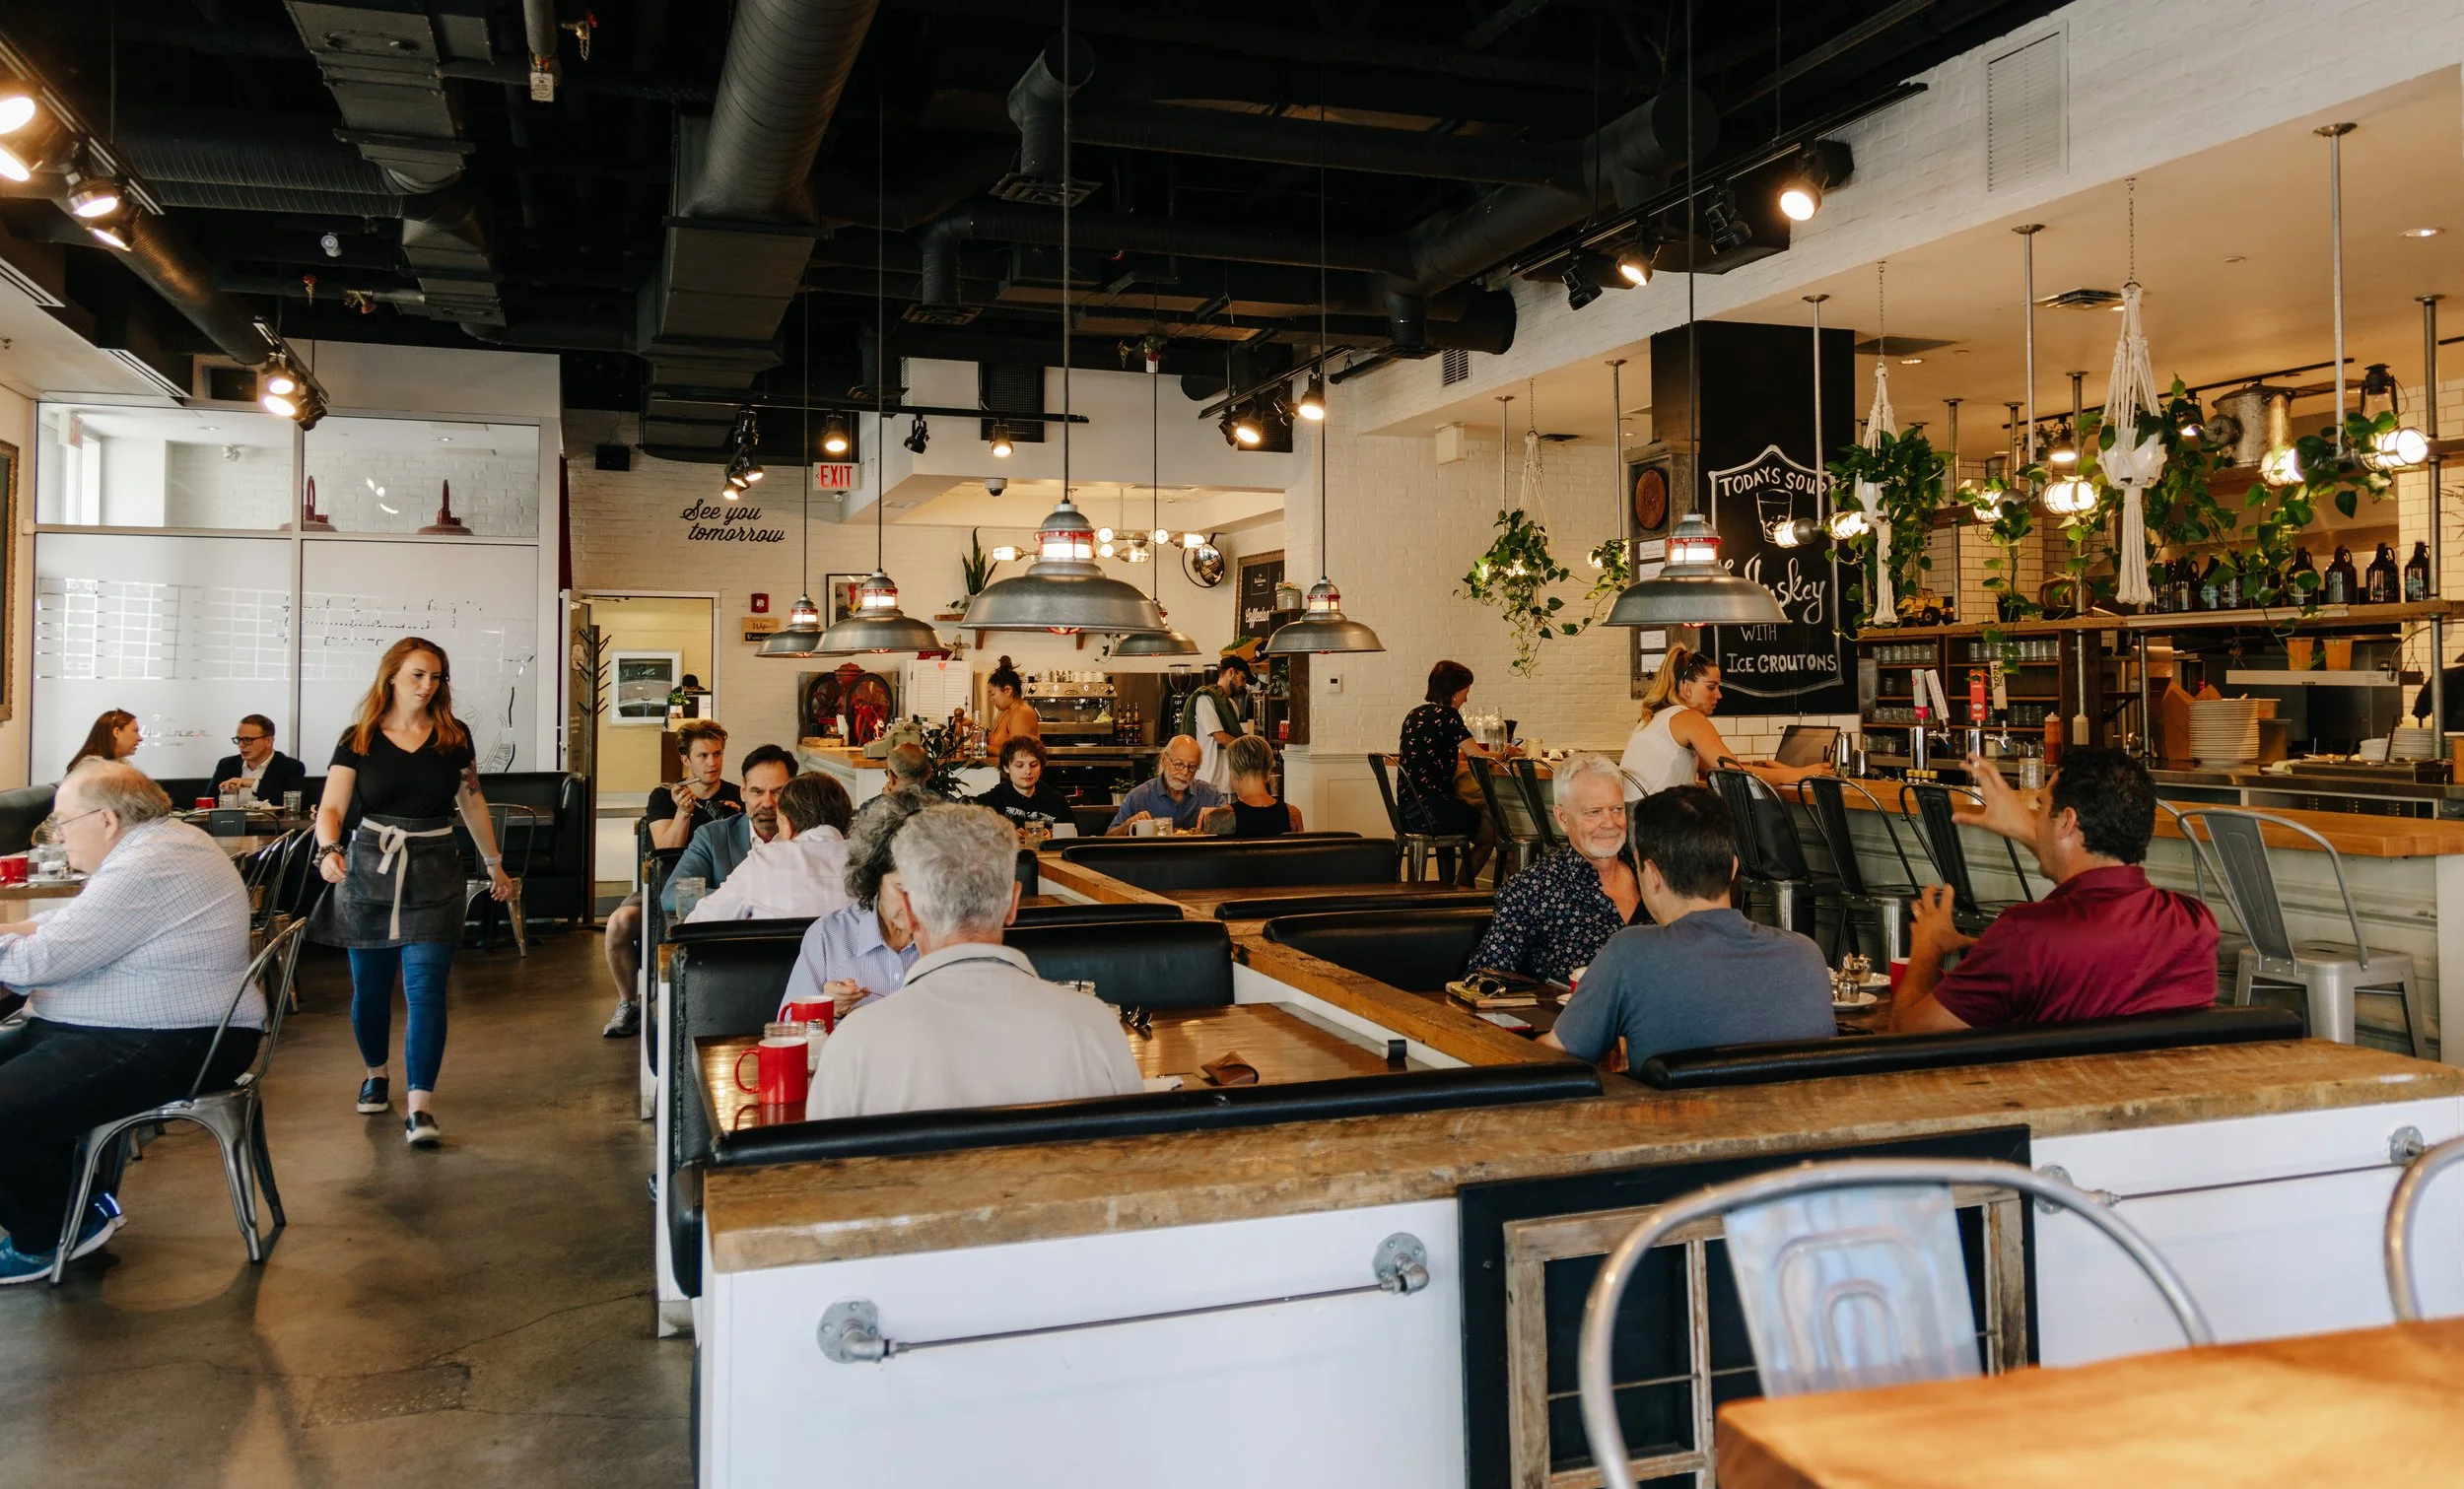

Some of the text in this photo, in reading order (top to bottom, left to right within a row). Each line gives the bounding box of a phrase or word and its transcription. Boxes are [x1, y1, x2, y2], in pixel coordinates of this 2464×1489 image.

[820, 465, 853, 488] EXIT
[1719, 466, 1781, 497] TODAYS
[679, 499, 761, 525] See you
[688, 522, 785, 543] tomorrow
[1740, 624, 1777, 642] WITH
[1757, 654, 1837, 674] CROUTONS
